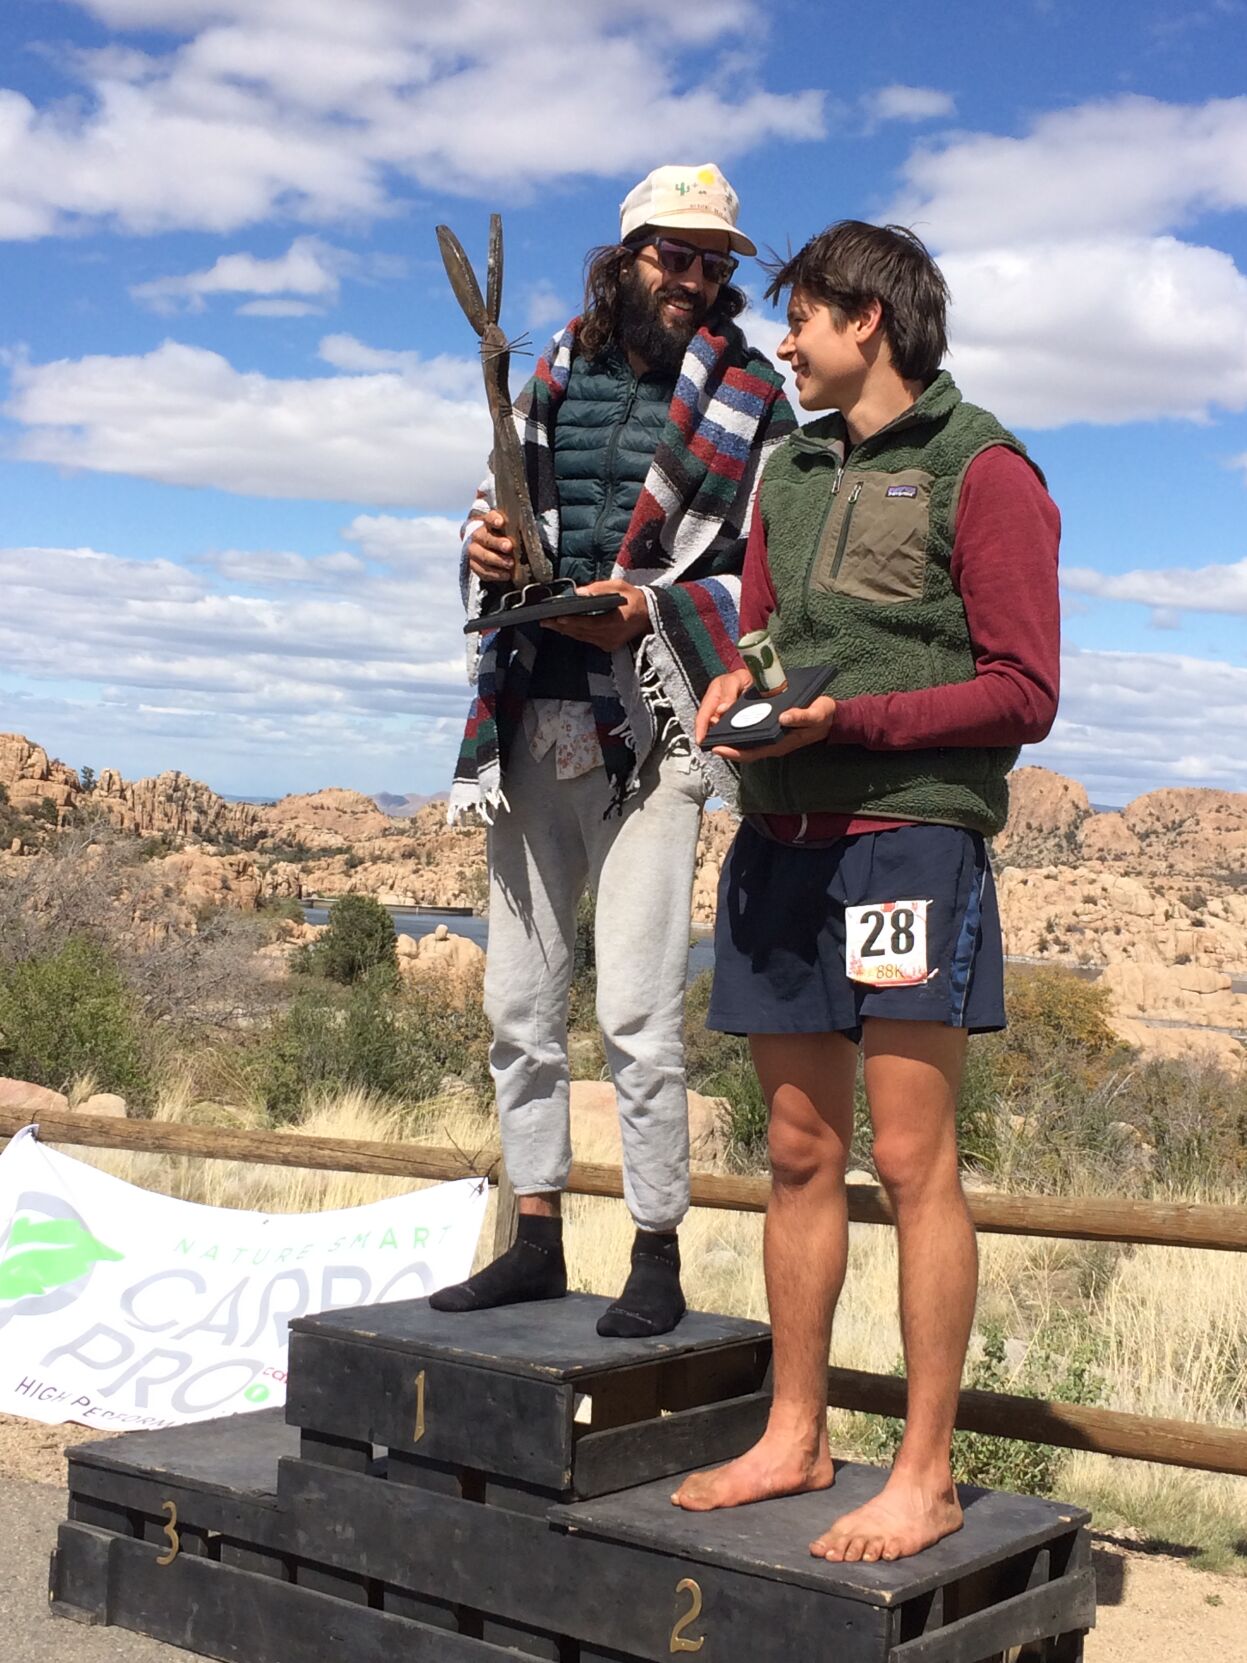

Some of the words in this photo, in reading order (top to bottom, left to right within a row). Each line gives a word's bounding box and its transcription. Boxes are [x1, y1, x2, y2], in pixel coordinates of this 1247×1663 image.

[860, 908, 915, 958] 28
[876, 963, 906, 980] 88K
[173, 1237, 314, 1265] NATURE
[327, 1224, 453, 1253] SMART
[14, 1375, 73, 1403] HIGH
[40, 1321, 265, 1414] PRO
[413, 1369, 426, 1443] 1
[156, 1500, 180, 1566] 3
[669, 1577, 704, 1653] 2
